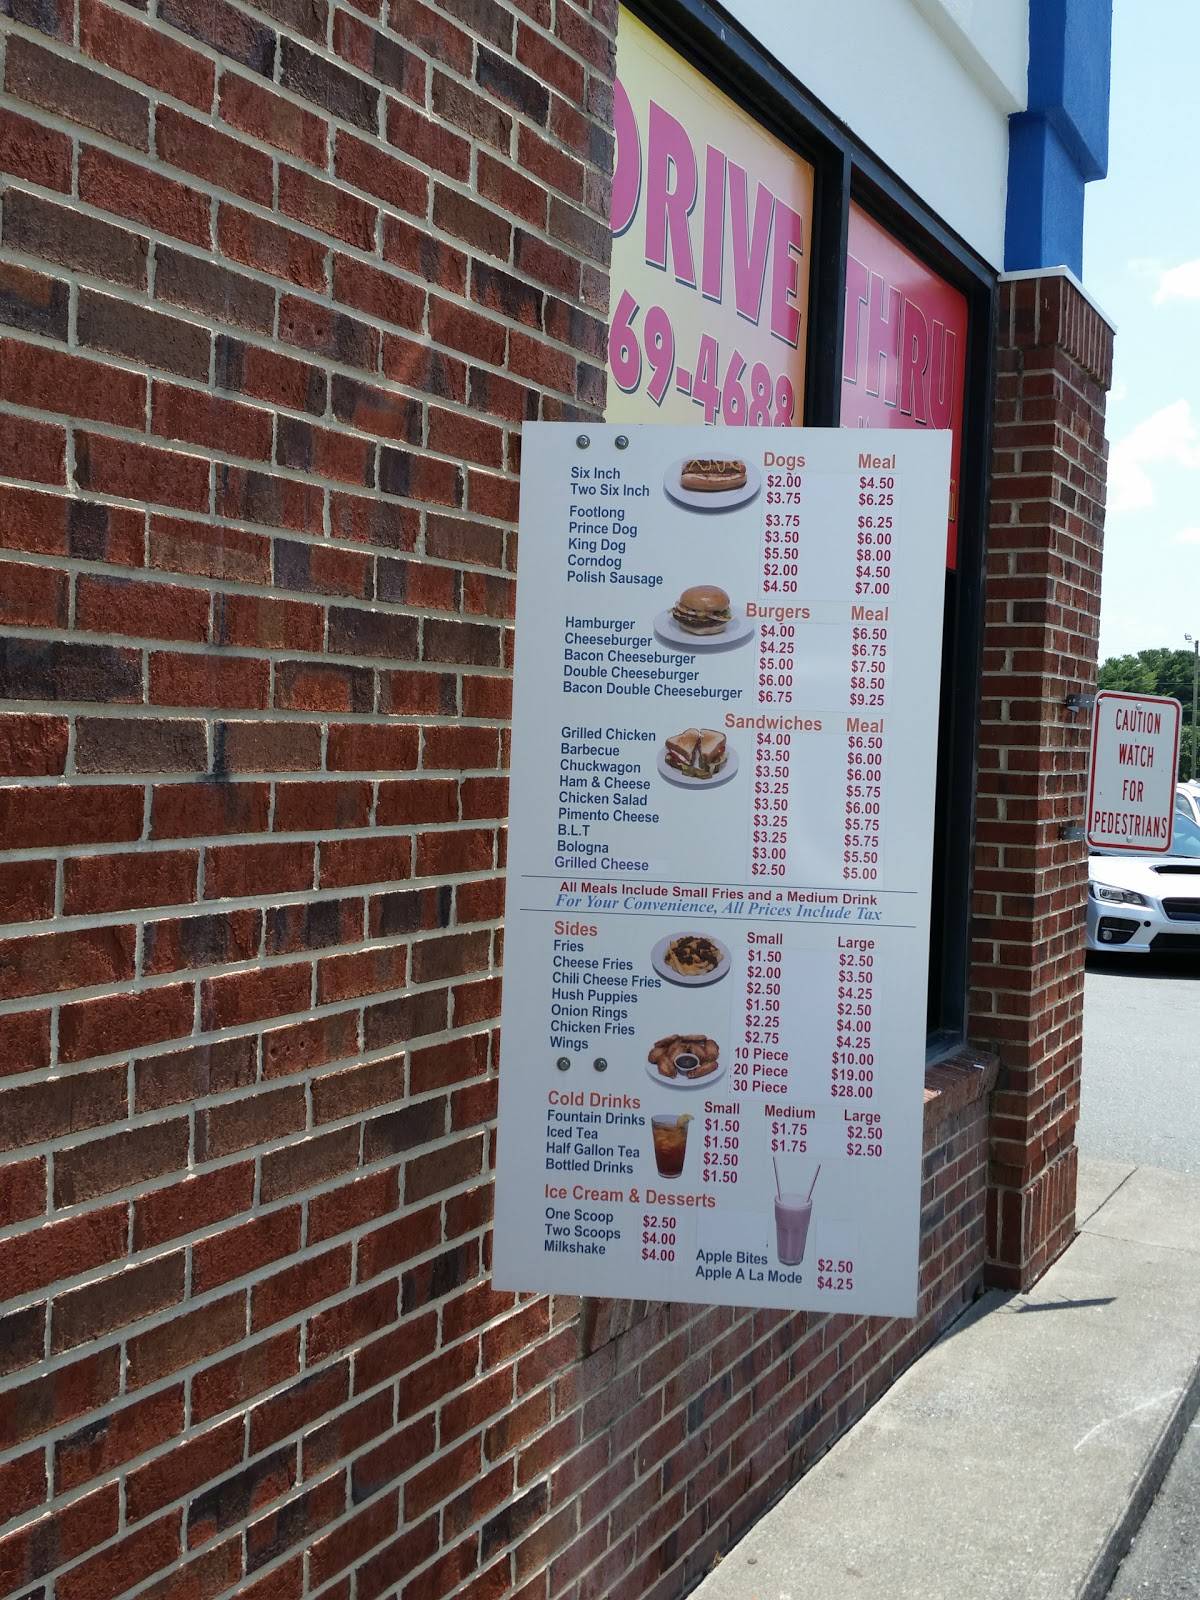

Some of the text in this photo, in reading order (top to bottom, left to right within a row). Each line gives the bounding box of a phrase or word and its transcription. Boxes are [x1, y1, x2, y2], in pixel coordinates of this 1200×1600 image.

[844, 254, 956, 430] THRU
[763, 452, 805, 470] Dogs
[858, 453, 895, 470] Meal
[571, 466, 620, 481] Six Inch
[570, 483, 650, 497] Two Six Inch
[859, 476, 894, 491] $4.50
[859, 493, 893, 507] $6.25
[570, 506, 624, 522] Footlong
[569, 522, 637, 538] Prince Dog
[858, 515, 892, 530] $6.25
[568, 538, 626, 554] King Dog
[857, 532, 892, 547] $6.00
[567, 554, 622, 570] Corndog
[856, 549, 891, 563] $8.00
[567, 571, 663, 587] Polish Sausage
[856, 565, 890, 580] $4.50
[855, 582, 890, 596] $7.00
[746, 603, 810, 621] Burgers
[851, 606, 889, 621] Meal
[565, 616, 635, 632] Hamburger
[565, 633, 652, 648] Cheeseburger
[852, 627, 887, 641] $6.50
[564, 649, 696, 666] Bacon Cheeseburger
[759, 657, 794, 671] $5.00
[563, 665, 699, 682] Double Cheeseburger
[759, 674, 793, 688] $6.00
[563, 682, 742, 701] Bacon Double Cheeseburger
[758, 690, 792, 704] $6.75
[724, 713, 822, 733] Sandwiches
[846, 717, 884, 734] Meal
[1116, 709, 1161, 734] CAUTION
[561, 727, 656, 742] Grilled Chicken
[757, 732, 791, 746] $4.00
[561, 743, 619, 757] Barbecue
[756, 749, 790, 763] $3.50
[1119, 744, 1154, 768] WATCH
[560, 759, 640, 775] Chuckwagon
[755, 765, 789, 779] $3.50
[559, 775, 650, 790] Ham & Cheese
[754, 782, 789, 795] $3.25
[1123, 780, 1143, 802] FOR
[559, 792, 647, 806] Chicken Salad
[754, 798, 788, 812] $3.50
[558, 808, 659, 823] Pimento Cheese
[753, 814, 788, 828] $3.25
[558, 824, 589, 837] B.L.T
[1094, 811, 1168, 838] PEDESTRIANS
[557, 840, 609, 855] Bologna
[844, 834, 879, 848] $5.75
[555, 857, 648, 872] Grilled Cheese
[844, 851, 878, 865] $5.50
[843, 867, 877, 881] $5.00
[560, 882, 877, 905] All Meals Include Small Fries and a Medium Drink
[556, 894, 882, 920] For Your Convenience, All Prices Include Tax
[554, 920, 597, 936] Sides
[554, 940, 584, 952] Fries
[747, 932, 783, 945] Small
[838, 936, 875, 951] Large
[553, 956, 633, 970] Cheese Fries
[839, 954, 873, 967] $2.50
[553, 972, 661, 988] Chili Cheese Fries
[839, 970, 873, 983] $3.50
[552, 989, 638, 1004] Hush Puppies
[838, 987, 872, 1000] $4.25
[551, 1004, 628, 1021] Onion Rings
[837, 1003, 872, 1016] $2.50
[551, 1021, 635, 1035] Chicken Fries
[837, 1019, 871, 1032] $4.00
[550, 1036, 588, 1051] Wings
[735, 1048, 789, 1061] 10 Piece
[832, 1052, 873, 1065] $10.00
[734, 1064, 788, 1077] 20 Piece
[733, 1080, 788, 1094] 30 Piece
[831, 1084, 873, 1098] $28.00
[547, 1091, 641, 1109] Cold Drinks
[704, 1101, 740, 1115] Small
[764, 1104, 816, 1119] Medium
[547, 1110, 645, 1126] Fountain Drinks
[844, 1109, 881, 1125] Large
[546, 1126, 598, 1140] Iced Tea
[771, 1121, 807, 1136] $1.75
[704, 1135, 739, 1149] $1.50
[546, 1142, 639, 1158] Half Gallon Tea
[846, 1143, 882, 1157] $2.50
[545, 1158, 633, 1174] Bottled Drinks
[703, 1169, 738, 1184] $1.50
[545, 1184, 716, 1208] Ice Cream & Desserts
[545, 1207, 614, 1225] One Scoop
[544, 1224, 620, 1241] Two Scoops
[642, 1231, 676, 1246] $4.00
[544, 1240, 606, 1255] Milkshake
[696, 1250, 768, 1267] Apple Bites
[817, 1259, 853, 1274] $2.50
[695, 1266, 803, 1284] Apple A La Mode
